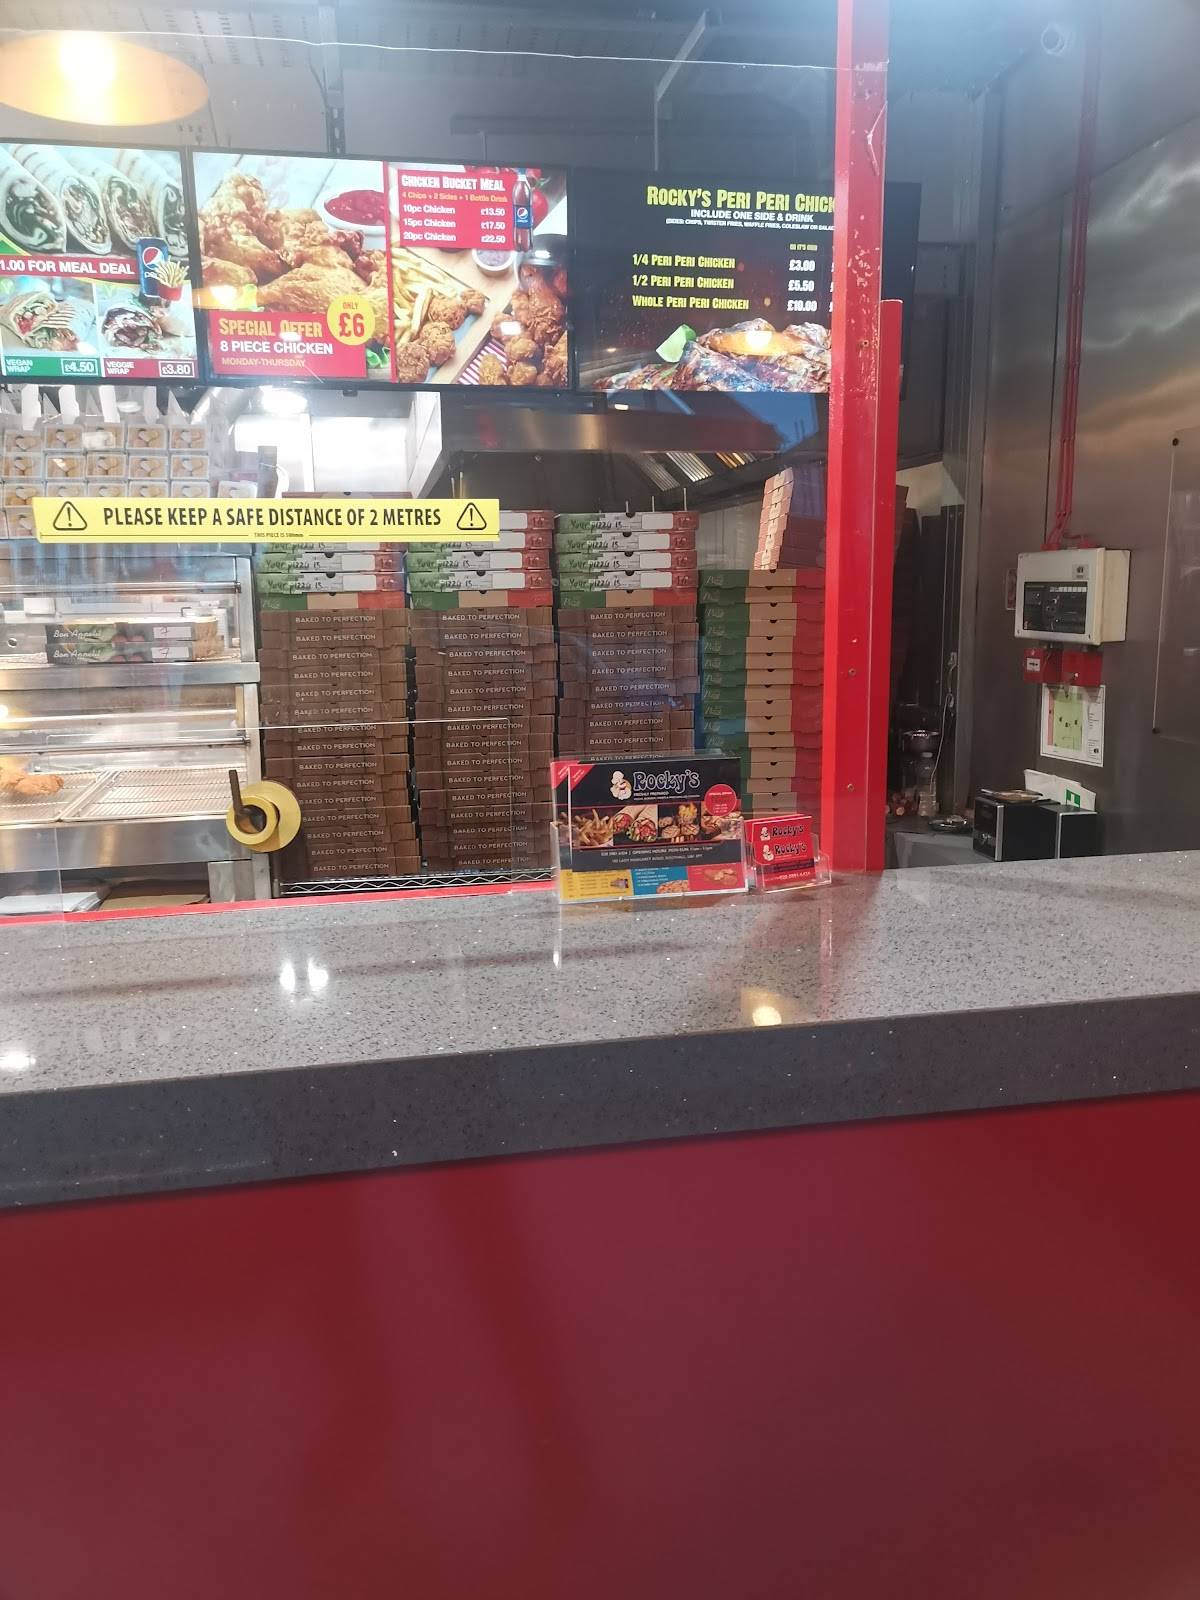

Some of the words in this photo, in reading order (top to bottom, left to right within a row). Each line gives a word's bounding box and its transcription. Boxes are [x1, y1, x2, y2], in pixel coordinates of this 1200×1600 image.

[402, 175, 440, 188] CHICKEN
[443, 176, 477, 189] BUCKET
[480, 178, 505, 191] MEAL
[646, 186, 711, 208] ROCKY'S
[716, 190, 750, 209] PERI
[756, 192, 790, 211] PERI
[403, 204, 422, 213] 10pc
[423, 205, 455, 214] Chicken
[481, 208, 505, 216] £13.50
[691, 209, 731, 219] INCLUDE
[733, 211, 753, 220] ONE
[754, 212, 775, 221] SIDE
[777, 213, 783, 221] &
[785, 213, 813, 222] DRINK
[403, 218, 422, 227] 15pc
[424, 219, 456, 228] Chicken
[481, 221, 505, 230] £17.50
[403, 232, 423, 241] 20pc
[424, 232, 456, 241] Chicken
[481, 235, 505, 243] £22.50
[28, 260, 56, 272] FOR
[59, 262, 97, 273] MEAL
[100, 262, 135, 275] DEAL
[632, 254, 648, 266] 1/4
[651, 254, 672, 266] PERI
[674, 255, 695, 267] PERI
[698, 256, 736, 269] CHICKEN
[789, 260, 816, 272] £3.00
[632, 275, 648, 287] 1/2
[651, 276, 671, 287] PERI
[674, 276, 694, 288] PERI
[697, 277, 734, 289] CHICKEN
[788, 280, 815, 292] £5.50
[343, 302, 358, 310] ONLY
[632, 295, 664, 307] WHOLE
[666, 296, 687, 308] PERI
[689, 297, 710, 308] PERI
[712, 297, 749, 310] CHICKEN
[787, 300, 817, 312] £10.00
[219, 318, 275, 336] SPECIAL
[280, 319, 322, 337] OFFER
[338, 313, 364, 338] £6
[220, 341, 228, 352] 8
[232, 341, 271, 353] PIECE
[273, 342, 333, 354] CHICKEN
[64, 361, 94, 372] £4.50
[221, 357, 307, 368] MONDAY-THURSDAY
[162, 365, 190, 374] £3.80
[103, 507, 163, 526] PLEASE
[168, 507, 207, 526] KEEP
[212, 508, 222, 525] A
[227, 508, 264, 526] SAFE
[269, 508, 342, 526] DISTANCE
[347, 508, 365, 526] OF
[370, 508, 378, 525] 2
[383, 508, 441, 525] METRES
[54, 630, 69, 638] Bon
[54, 650, 69, 658] Bon
[633, 769, 701, 794] Rocky's
